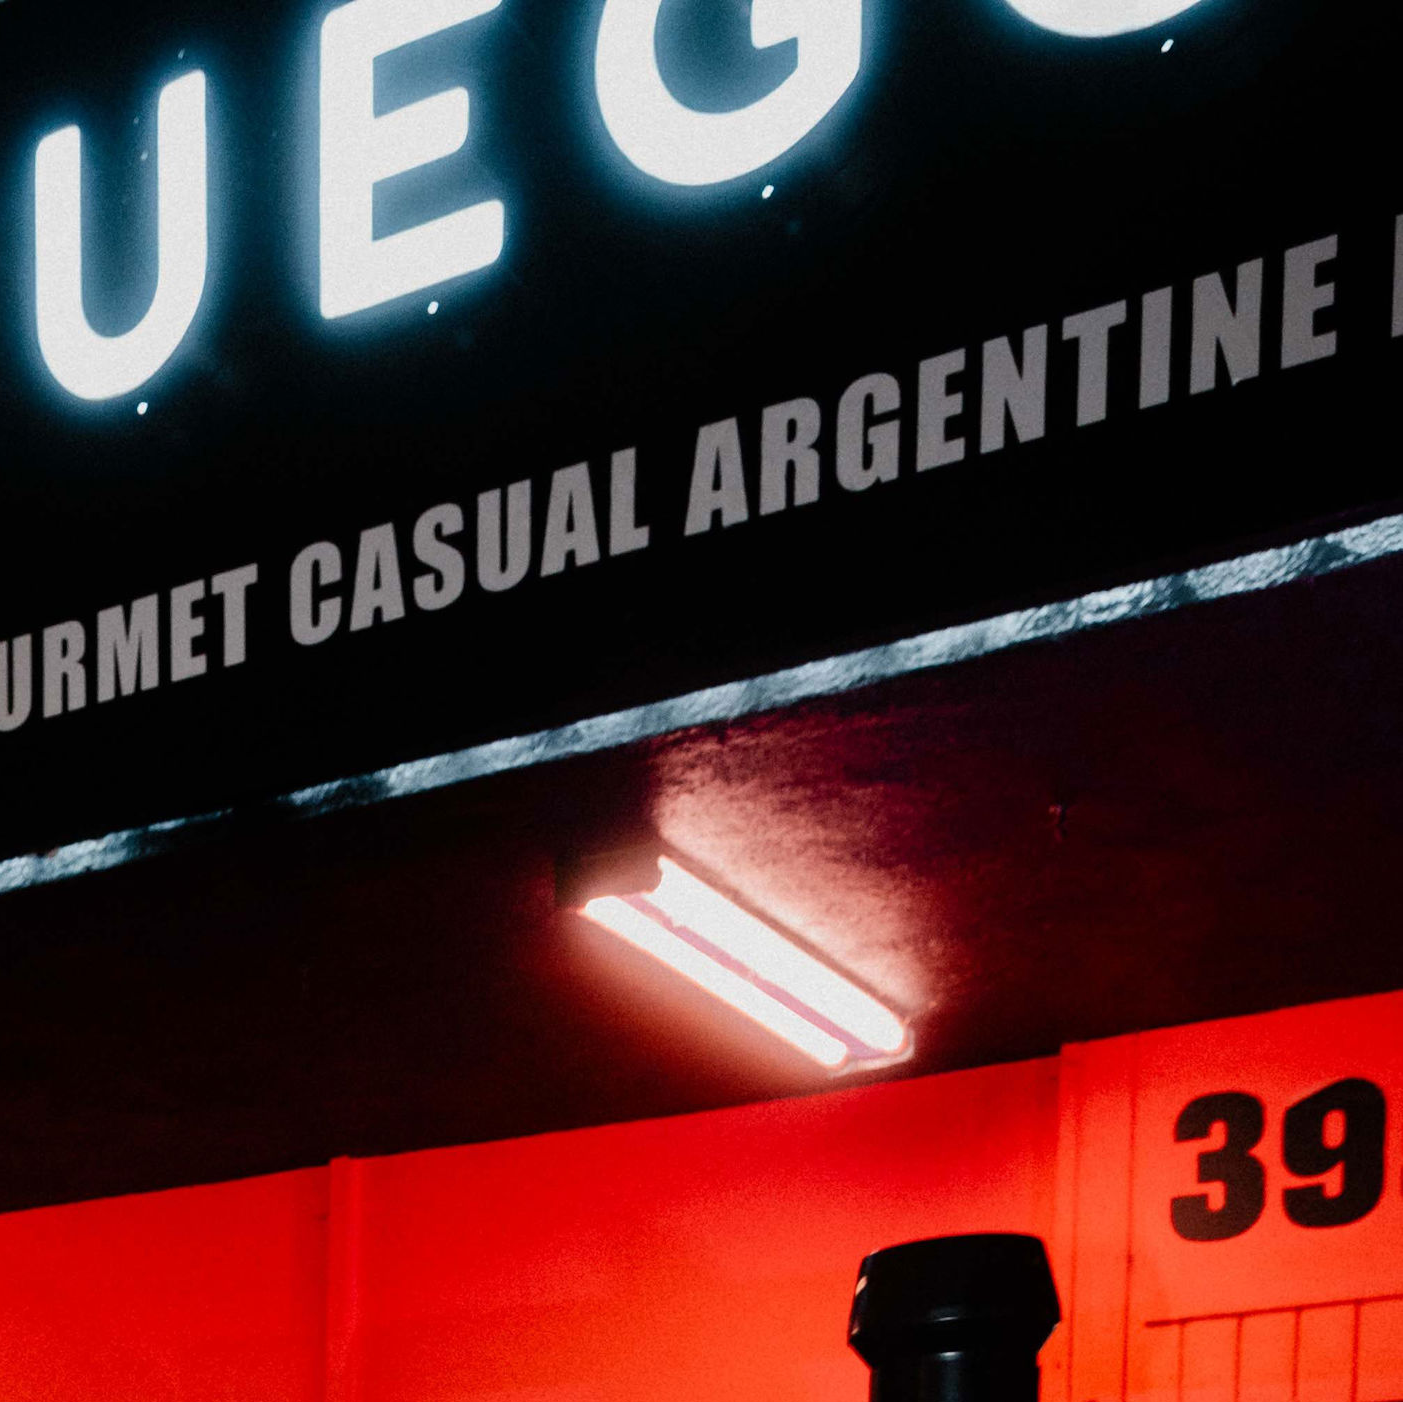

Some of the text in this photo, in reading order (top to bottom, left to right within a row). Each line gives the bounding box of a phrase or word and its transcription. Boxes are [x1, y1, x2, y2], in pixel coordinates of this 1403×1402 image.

[288, 446, 650, 647] CASUAL
[684, 233, 1338, 537] ARGENTINE
[1170, 1077, 1403, 1241] 39
